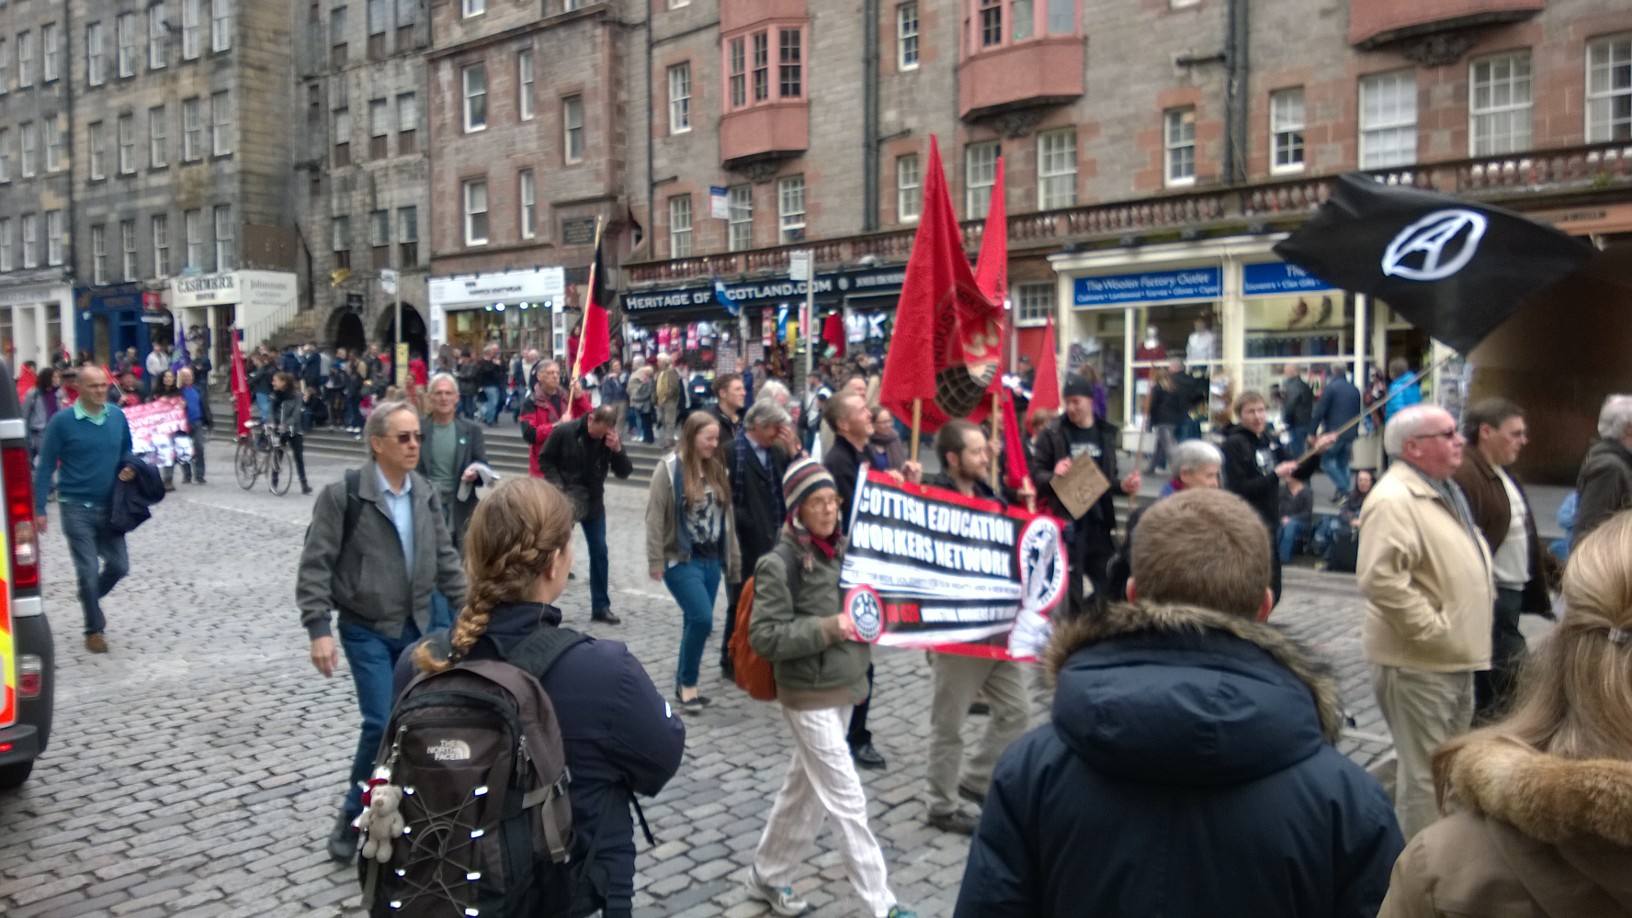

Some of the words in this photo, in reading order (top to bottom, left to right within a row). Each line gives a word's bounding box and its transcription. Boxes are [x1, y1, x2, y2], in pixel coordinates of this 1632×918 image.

[178, 276, 233, 293] CASHMERE
[1086, 280, 1103, 291] The
[1140, 275, 1176, 288] Factory
[1177, 273, 1209, 285] Outlet
[626, 294, 689, 310] HERITAGE
[693, 292, 711, 304] OF
[725, 280, 832, 301] COTLAND.COM
[859, 486, 926, 528] COTTISH
[928, 504, 1014, 546] EDUCATION
[853, 521, 934, 563] WORKERS
[934, 540, 1011, 578] NETWORK
[427, 746, 455, 754] NORTH
